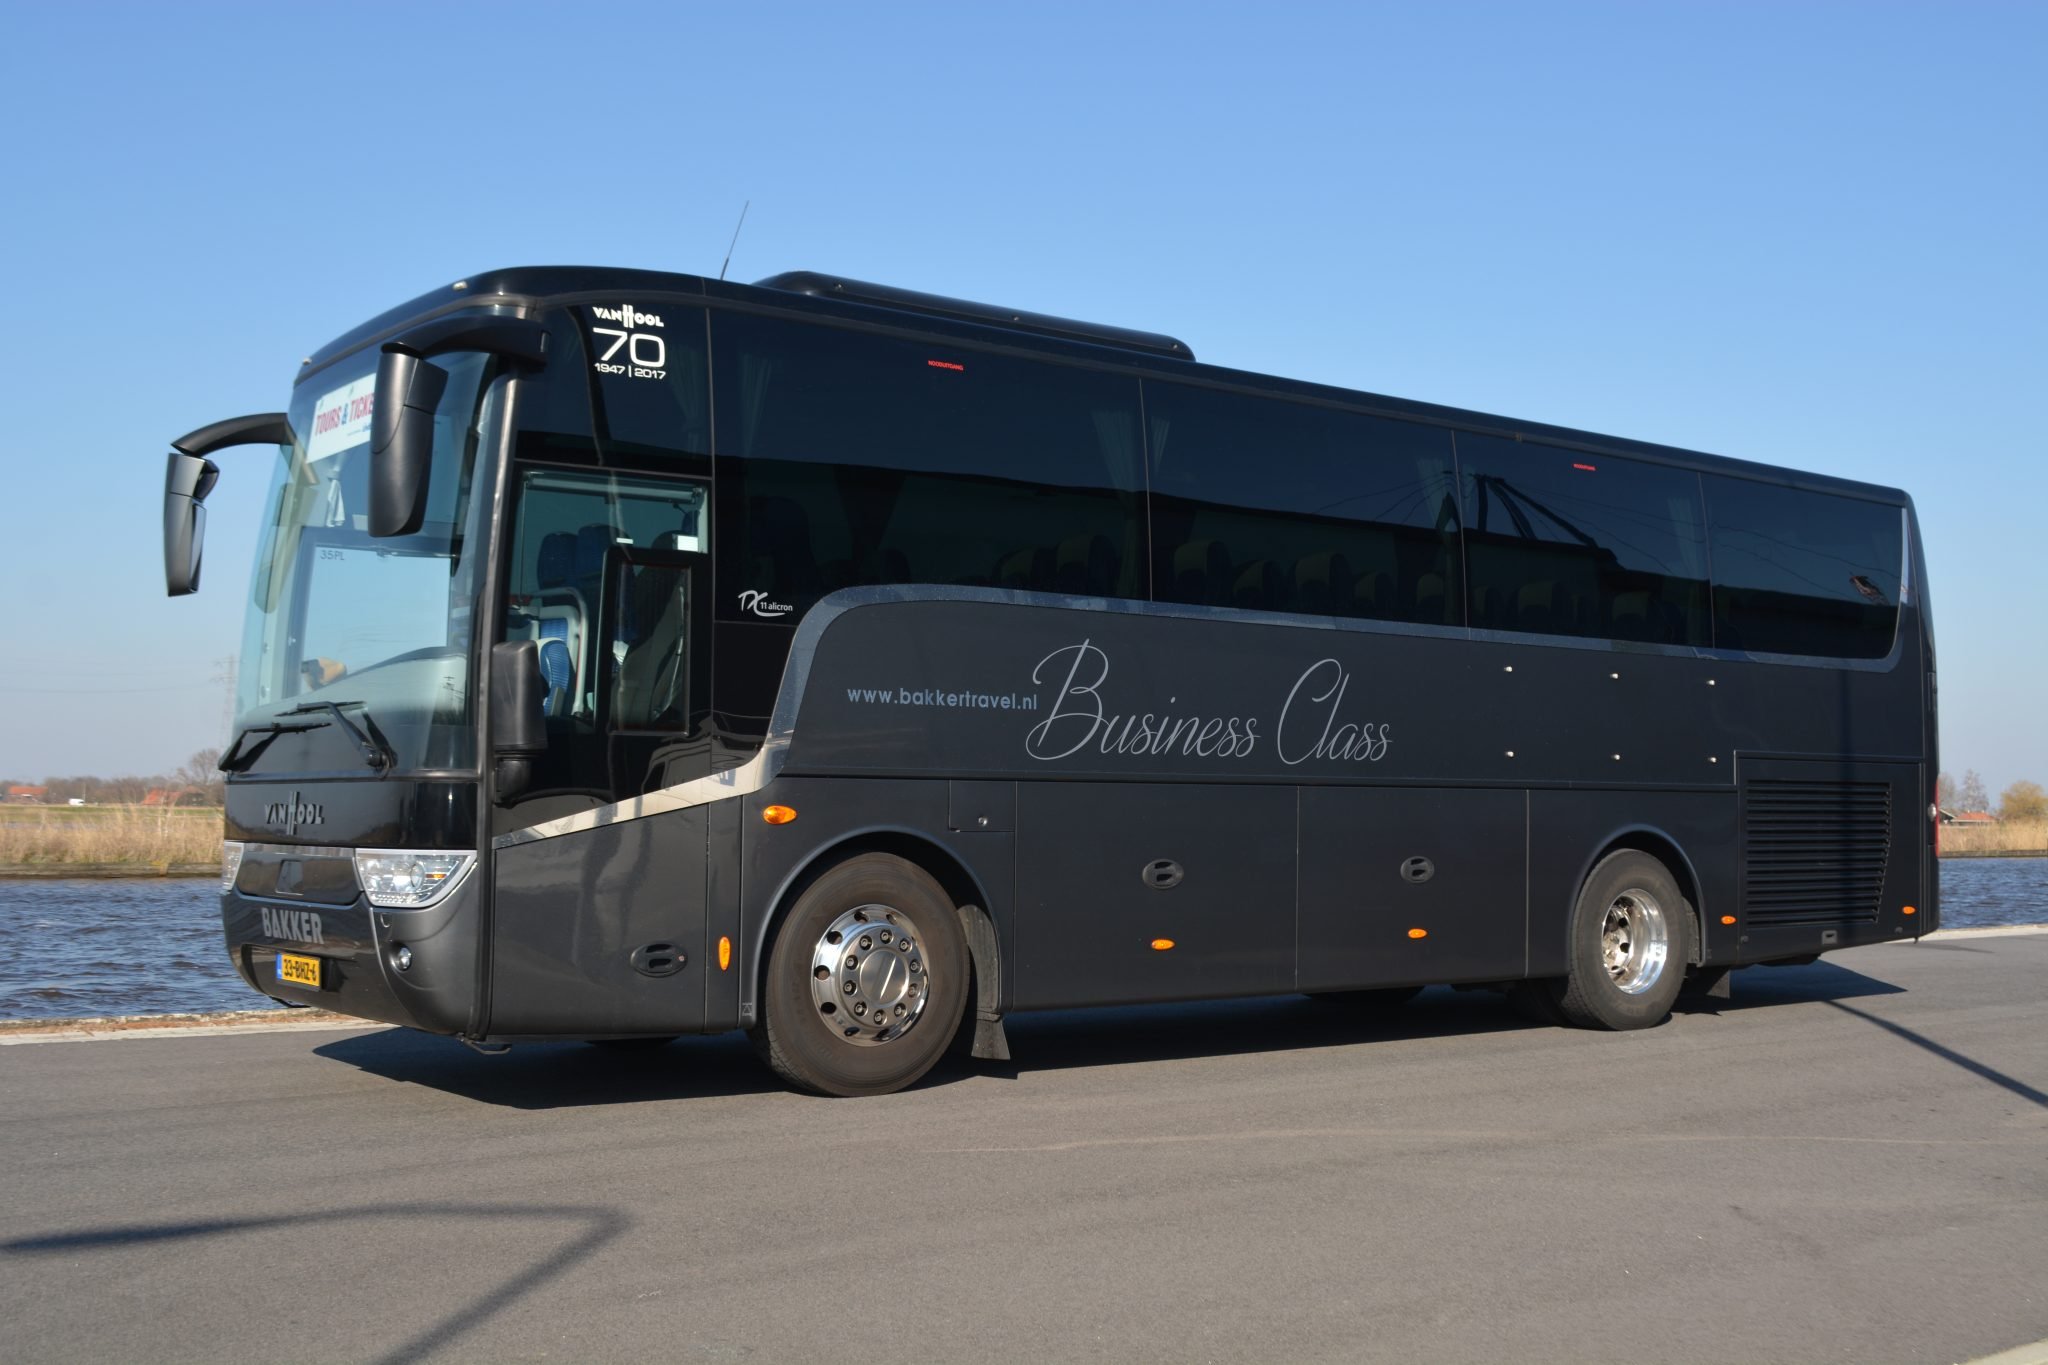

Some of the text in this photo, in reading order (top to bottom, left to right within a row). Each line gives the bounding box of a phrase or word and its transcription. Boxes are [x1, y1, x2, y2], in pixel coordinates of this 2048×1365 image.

[593, 327, 665, 367] 70
[315, 405, 342, 436] TOURS
[760, 601, 767, 610] 11
[768, 601, 793, 612] alicron
[847, 687, 1038, 710] www.bakkertravel.nl
[1025, 638, 1393, 765] Business Class
[261, 907, 324, 944] BAKKER
